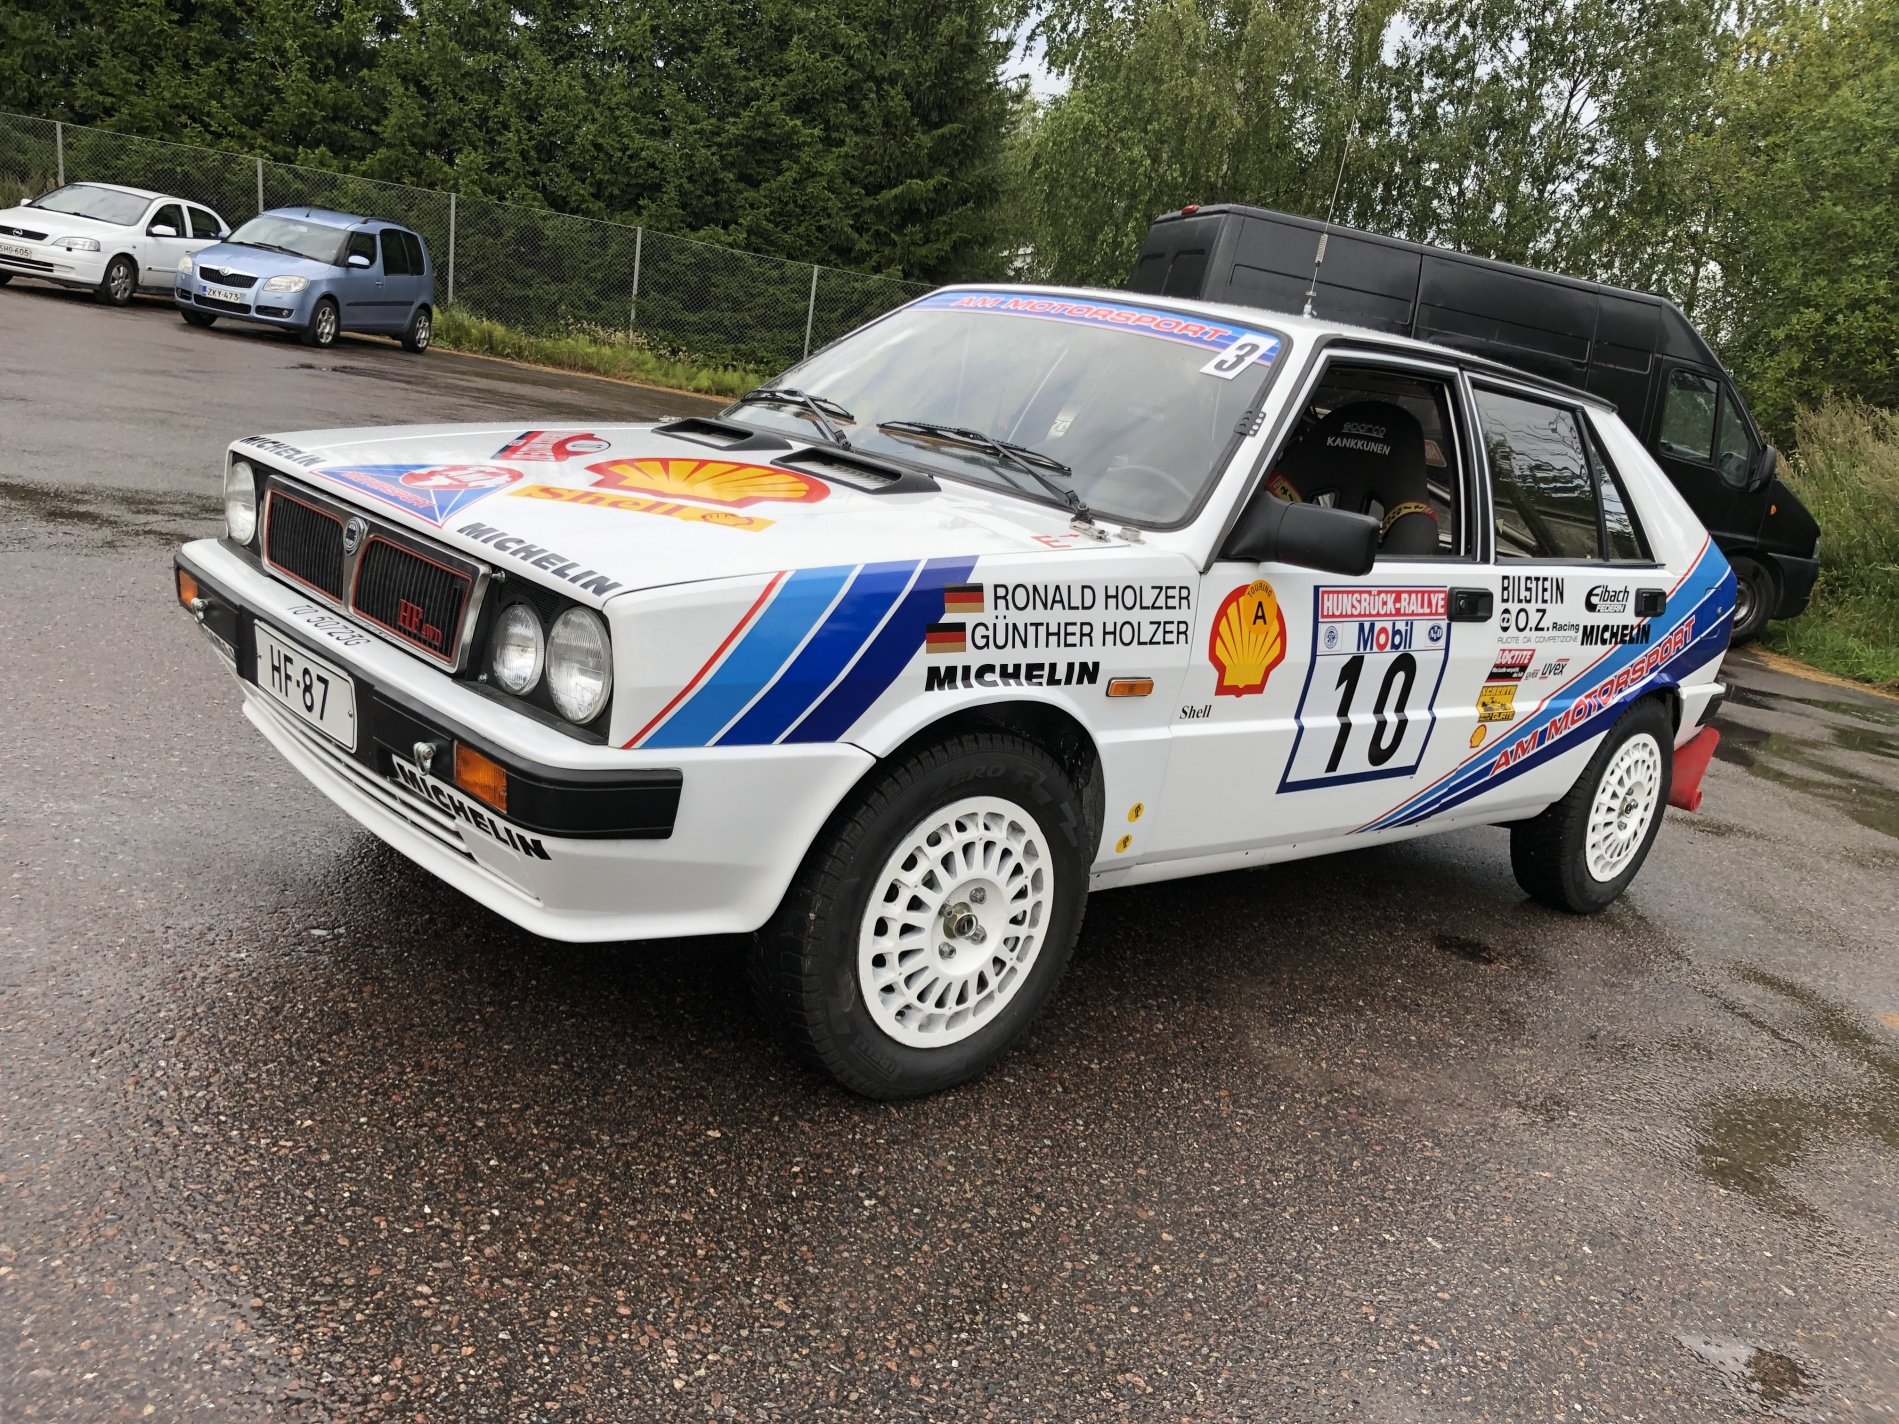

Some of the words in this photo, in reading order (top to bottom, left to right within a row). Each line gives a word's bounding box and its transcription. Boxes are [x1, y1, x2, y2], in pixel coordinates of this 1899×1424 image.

[207, 287, 239, 301] ZKY-473
[949, 296, 1003, 308] AM
[1001, 298, 1231, 341] MOTORSPORT
[1213, 342, 1260, 373] 3
[239, 436, 328, 467] MICHELIN
[1326, 436, 1391, 455] KANKKUNEN
[523, 486, 688, 517] Shell
[456, 522, 623, 597] MICHELIN
[993, 583, 1096, 611] RONALD
[1104, 585, 1191, 610] HOLZER
[1323, 590, 1446, 616] HUNSRÜCK-RALLYE
[1501, 575, 1564, 604] BILSTEIN
[1584, 584, 1630, 613] Eibach
[397, 598, 424, 633] HF
[1252, 600, 1267, 625] A
[1515, 607, 1550, 633] O.Z.
[1551, 621, 1580, 634] Racing
[1596, 604, 1626, 613] FEDERN
[970, 615, 1094, 650] GÜNTHER
[1102, 620, 1189, 646] HOLZER
[1356, 621, 1414, 652] Mobil
[1522, 636, 1532, 644] DA
[1580, 623, 1652, 647] MICHELIN
[1495, 650, 1534, 665] LOCTITE
[1541, 662, 1568, 677] uvex
[269, 644, 330, 721] HF-87
[924, 661, 1100, 692] MICHELIN
[1489, 729, 1540, 777] AM
[1545, 614, 1697, 744] MOTORSPORT
[1179, 704, 1212, 720] Shell
[1324, 652, 1418, 774] 10
[396, 761, 552, 861] MICHELIN
